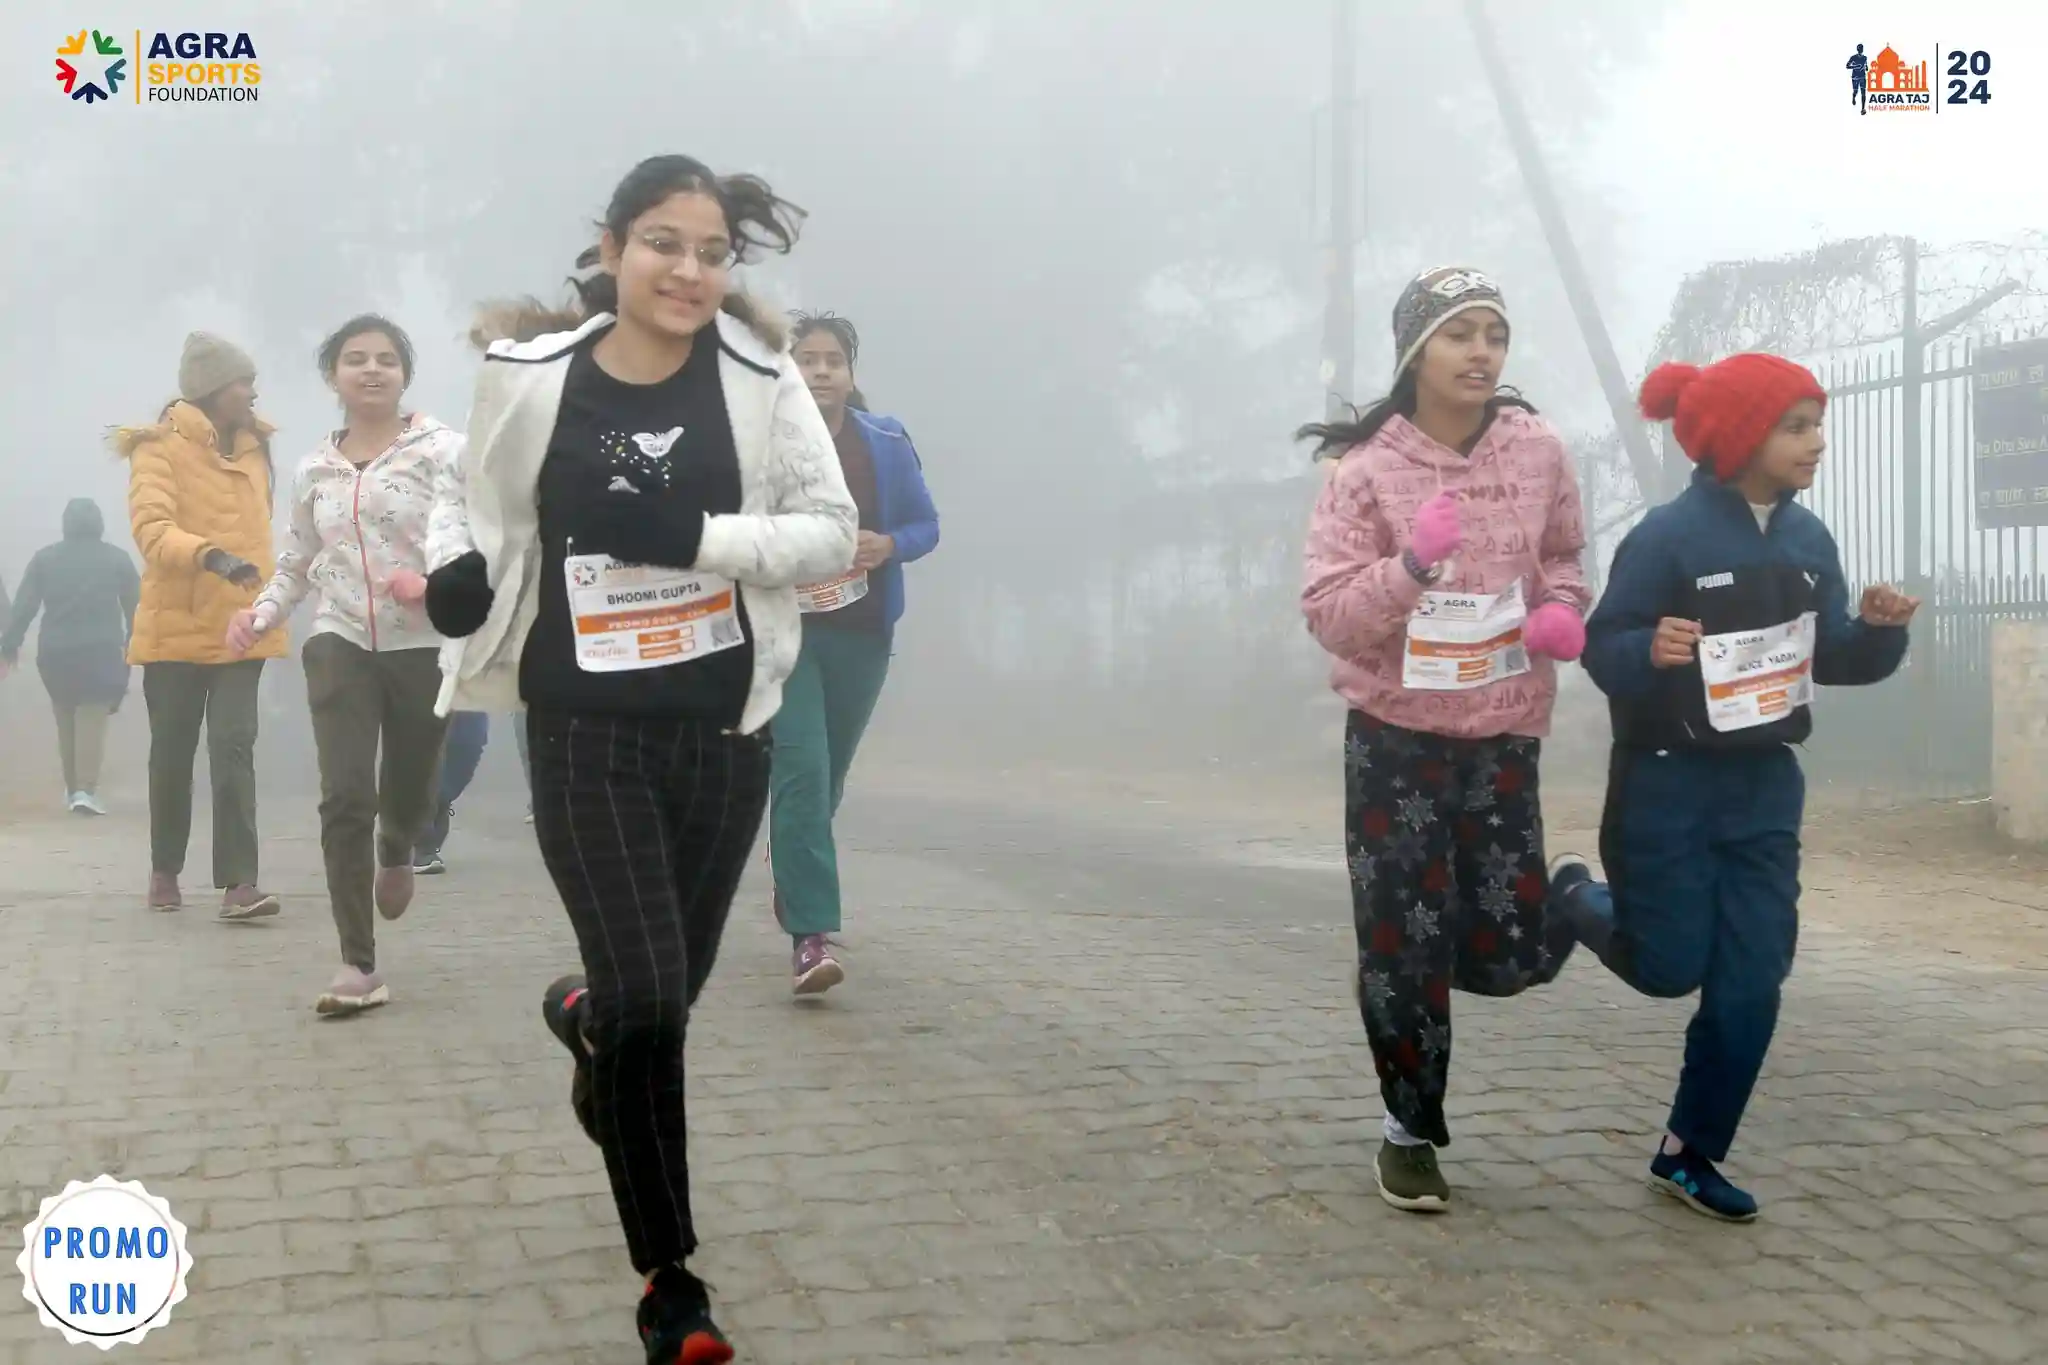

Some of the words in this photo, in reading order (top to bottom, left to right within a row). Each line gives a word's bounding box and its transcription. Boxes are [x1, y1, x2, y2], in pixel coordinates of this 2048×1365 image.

[607, 590, 658, 605] BHOOMI
[660, 582, 701, 599] GUPTA
[1443, 599, 1477, 608] AGRA
